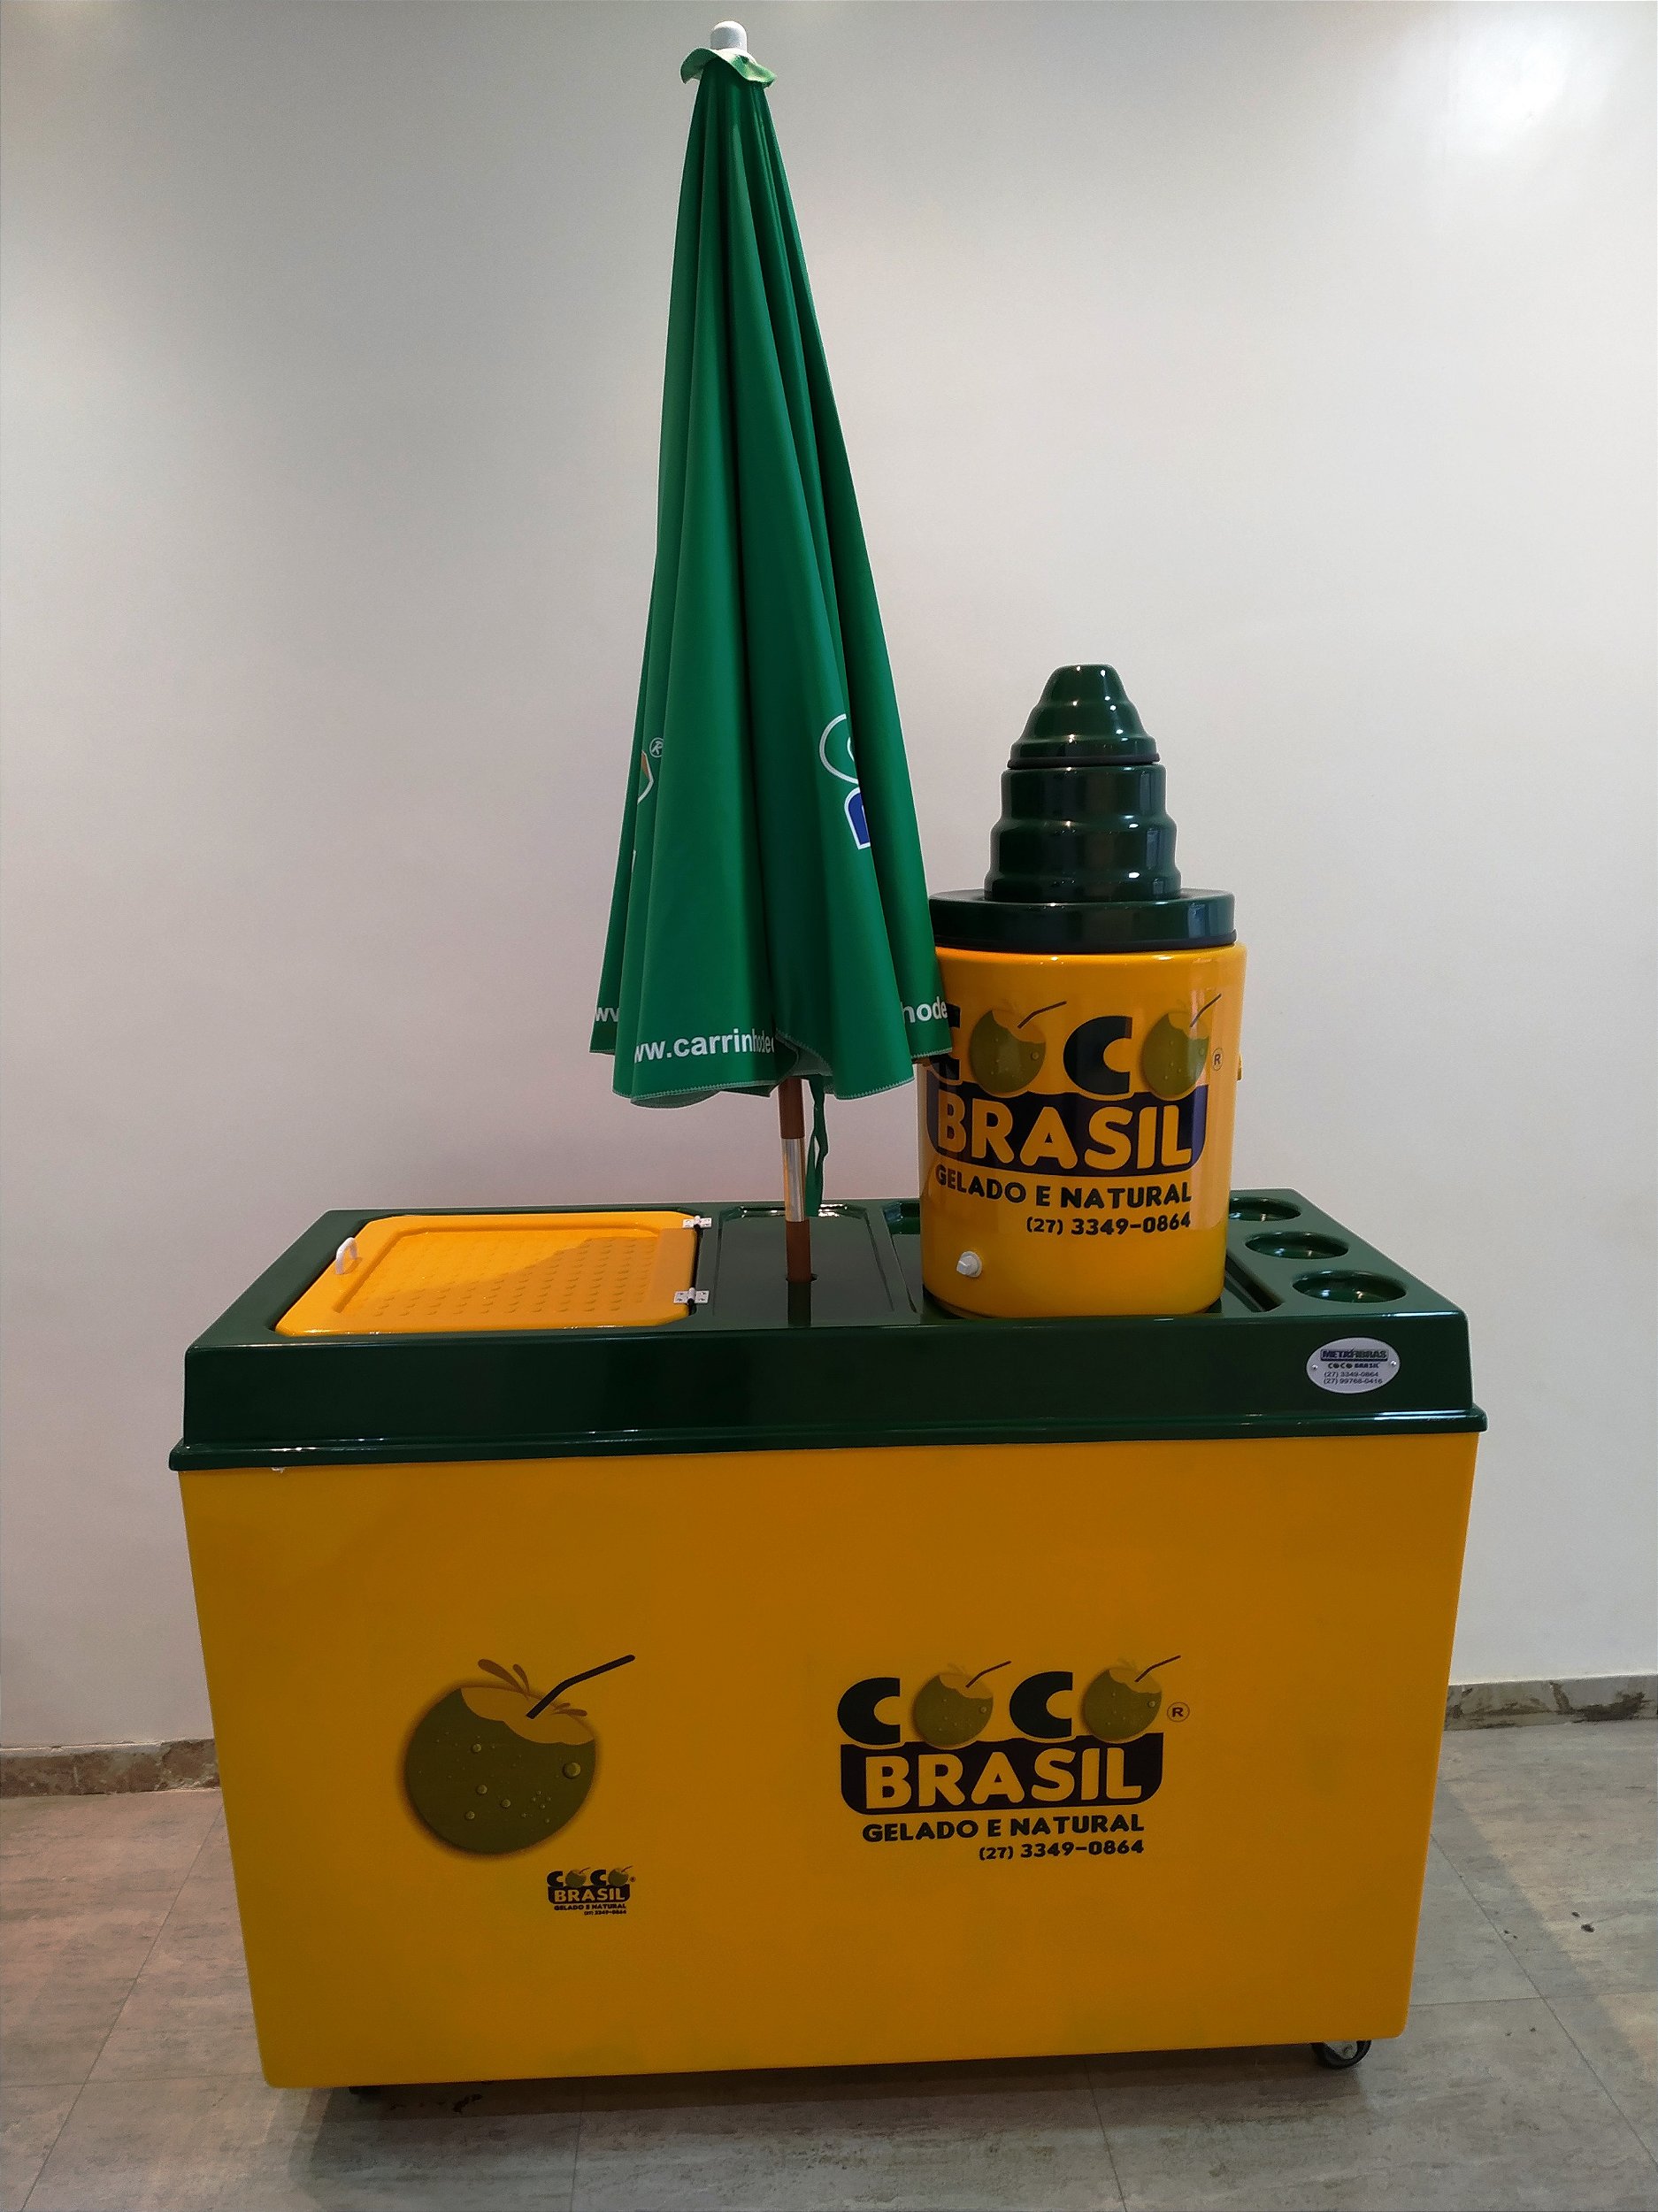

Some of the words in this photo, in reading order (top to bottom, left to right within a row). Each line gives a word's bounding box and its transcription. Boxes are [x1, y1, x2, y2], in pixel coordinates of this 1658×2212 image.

[938, 1090, 1193, 1171] BRASIL
[935, 1164, 1026, 1203] GELADO
[1036, 1186, 1051, 1207] E
[1061, 1182, 1193, 1210] NATURAL
[1026, 1216, 1063, 1236] (27)
[1071, 1211, 1192, 1236] 3349-0864
[837, 1667, 1163, 1748] COCO
[865, 1747, 1142, 1809] BRASIL
[862, 1819, 979, 1842] GELADO
[987, 1818, 1002, 1837] E
[1010, 1814, 1144, 1836] NATURAL
[979, 1846, 1013, 1861] (27)
[1021, 1839, 1144, 1858] 3349-0864
[547, 1869, 629, 1888] COCO
[554, 1888, 626, 1902] BRASIL
